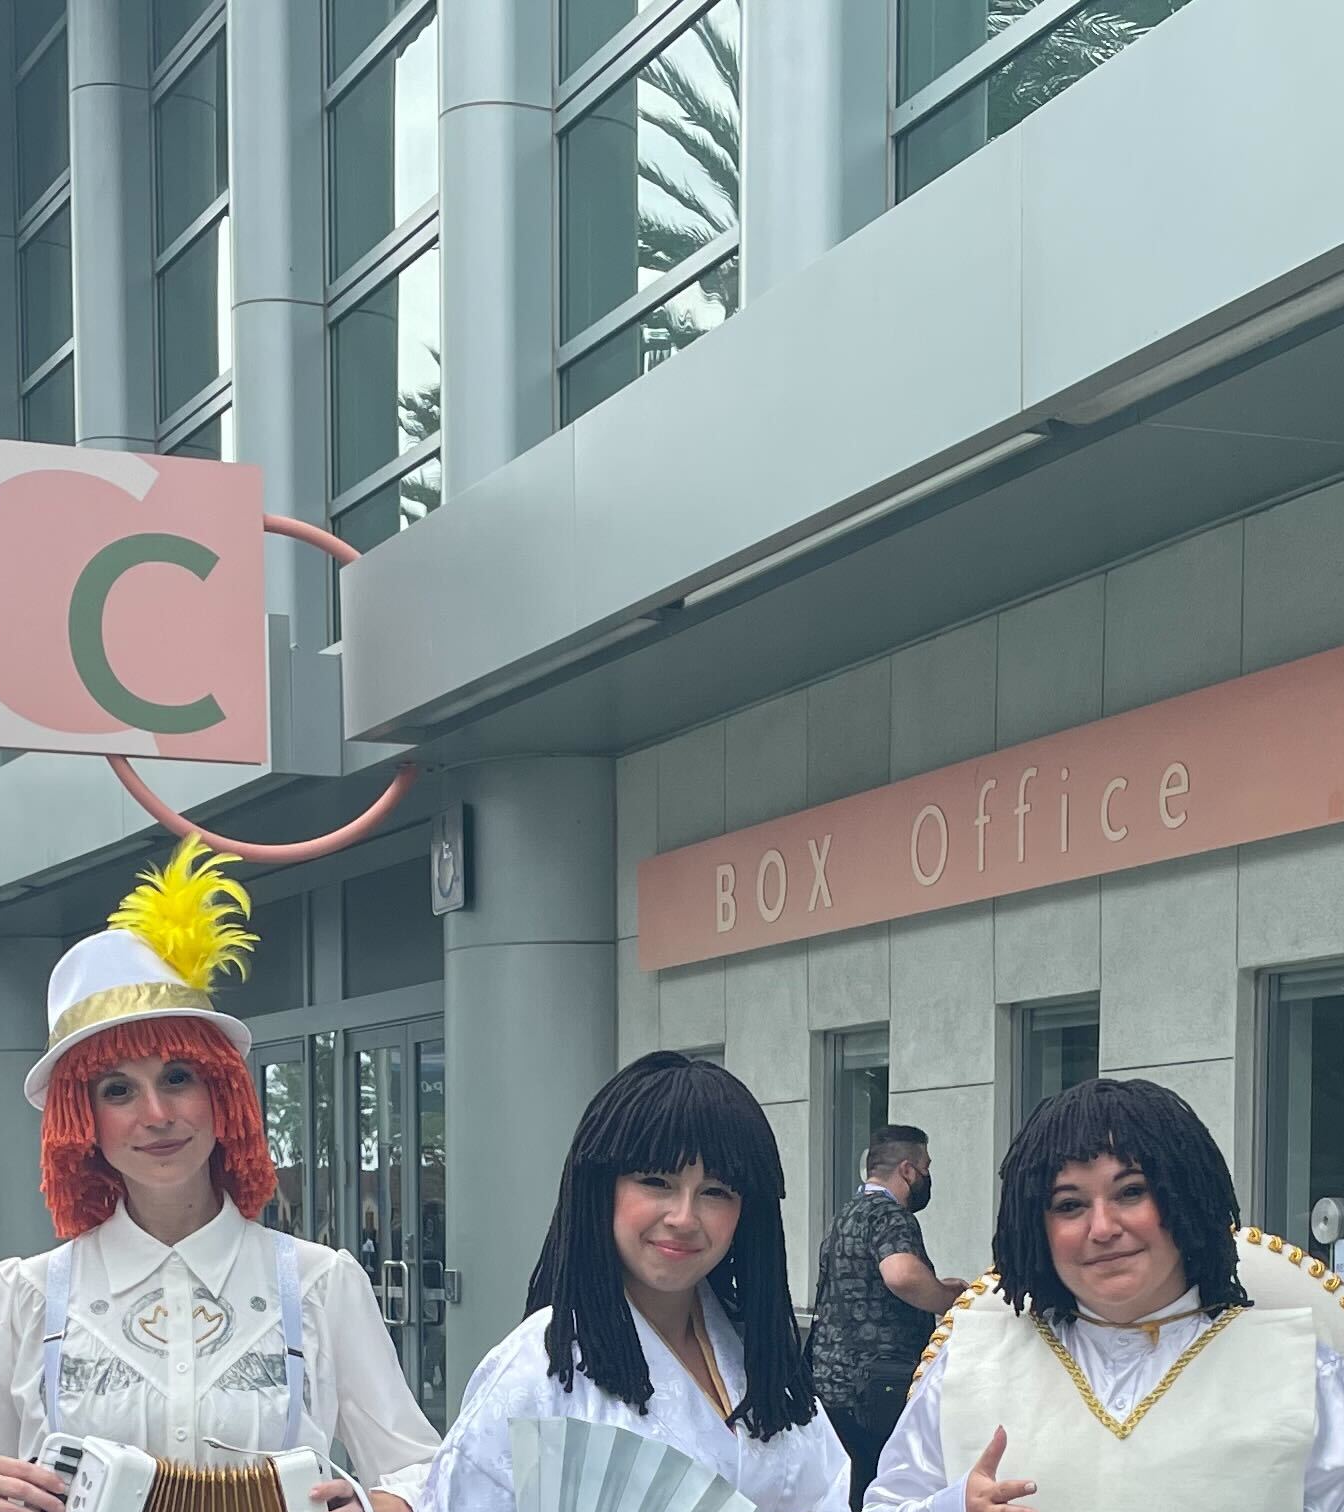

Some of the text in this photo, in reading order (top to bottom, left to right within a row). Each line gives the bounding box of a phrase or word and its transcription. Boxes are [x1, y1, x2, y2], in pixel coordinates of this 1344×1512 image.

[68, 532, 227, 735] C
[715, 761, 1191, 933] BOX Office
